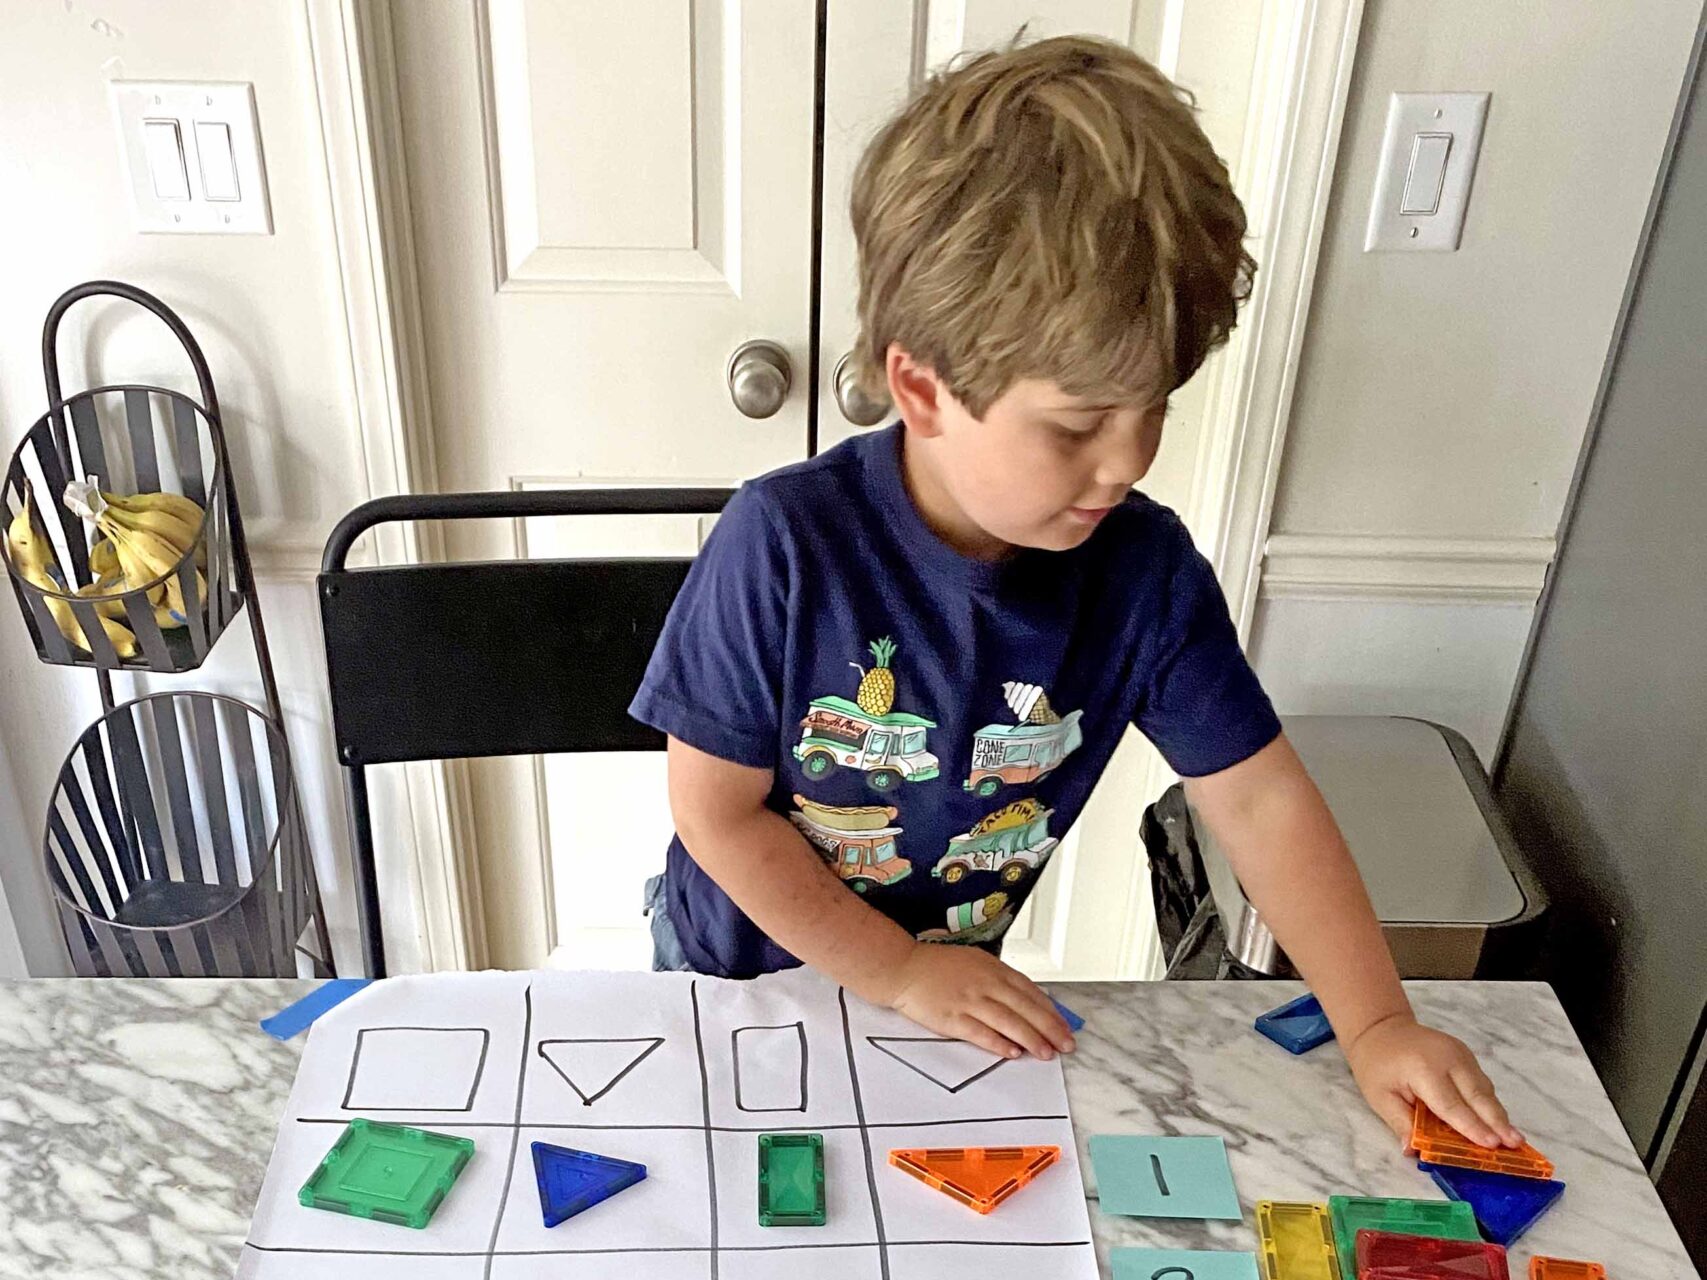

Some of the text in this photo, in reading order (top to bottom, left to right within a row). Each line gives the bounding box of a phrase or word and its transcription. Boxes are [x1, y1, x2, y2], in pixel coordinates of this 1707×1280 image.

[976, 738, 1005, 754] CONE
[974, 754, 1003, 768] ZONE
[1149, 1154, 1171, 1197] 1
